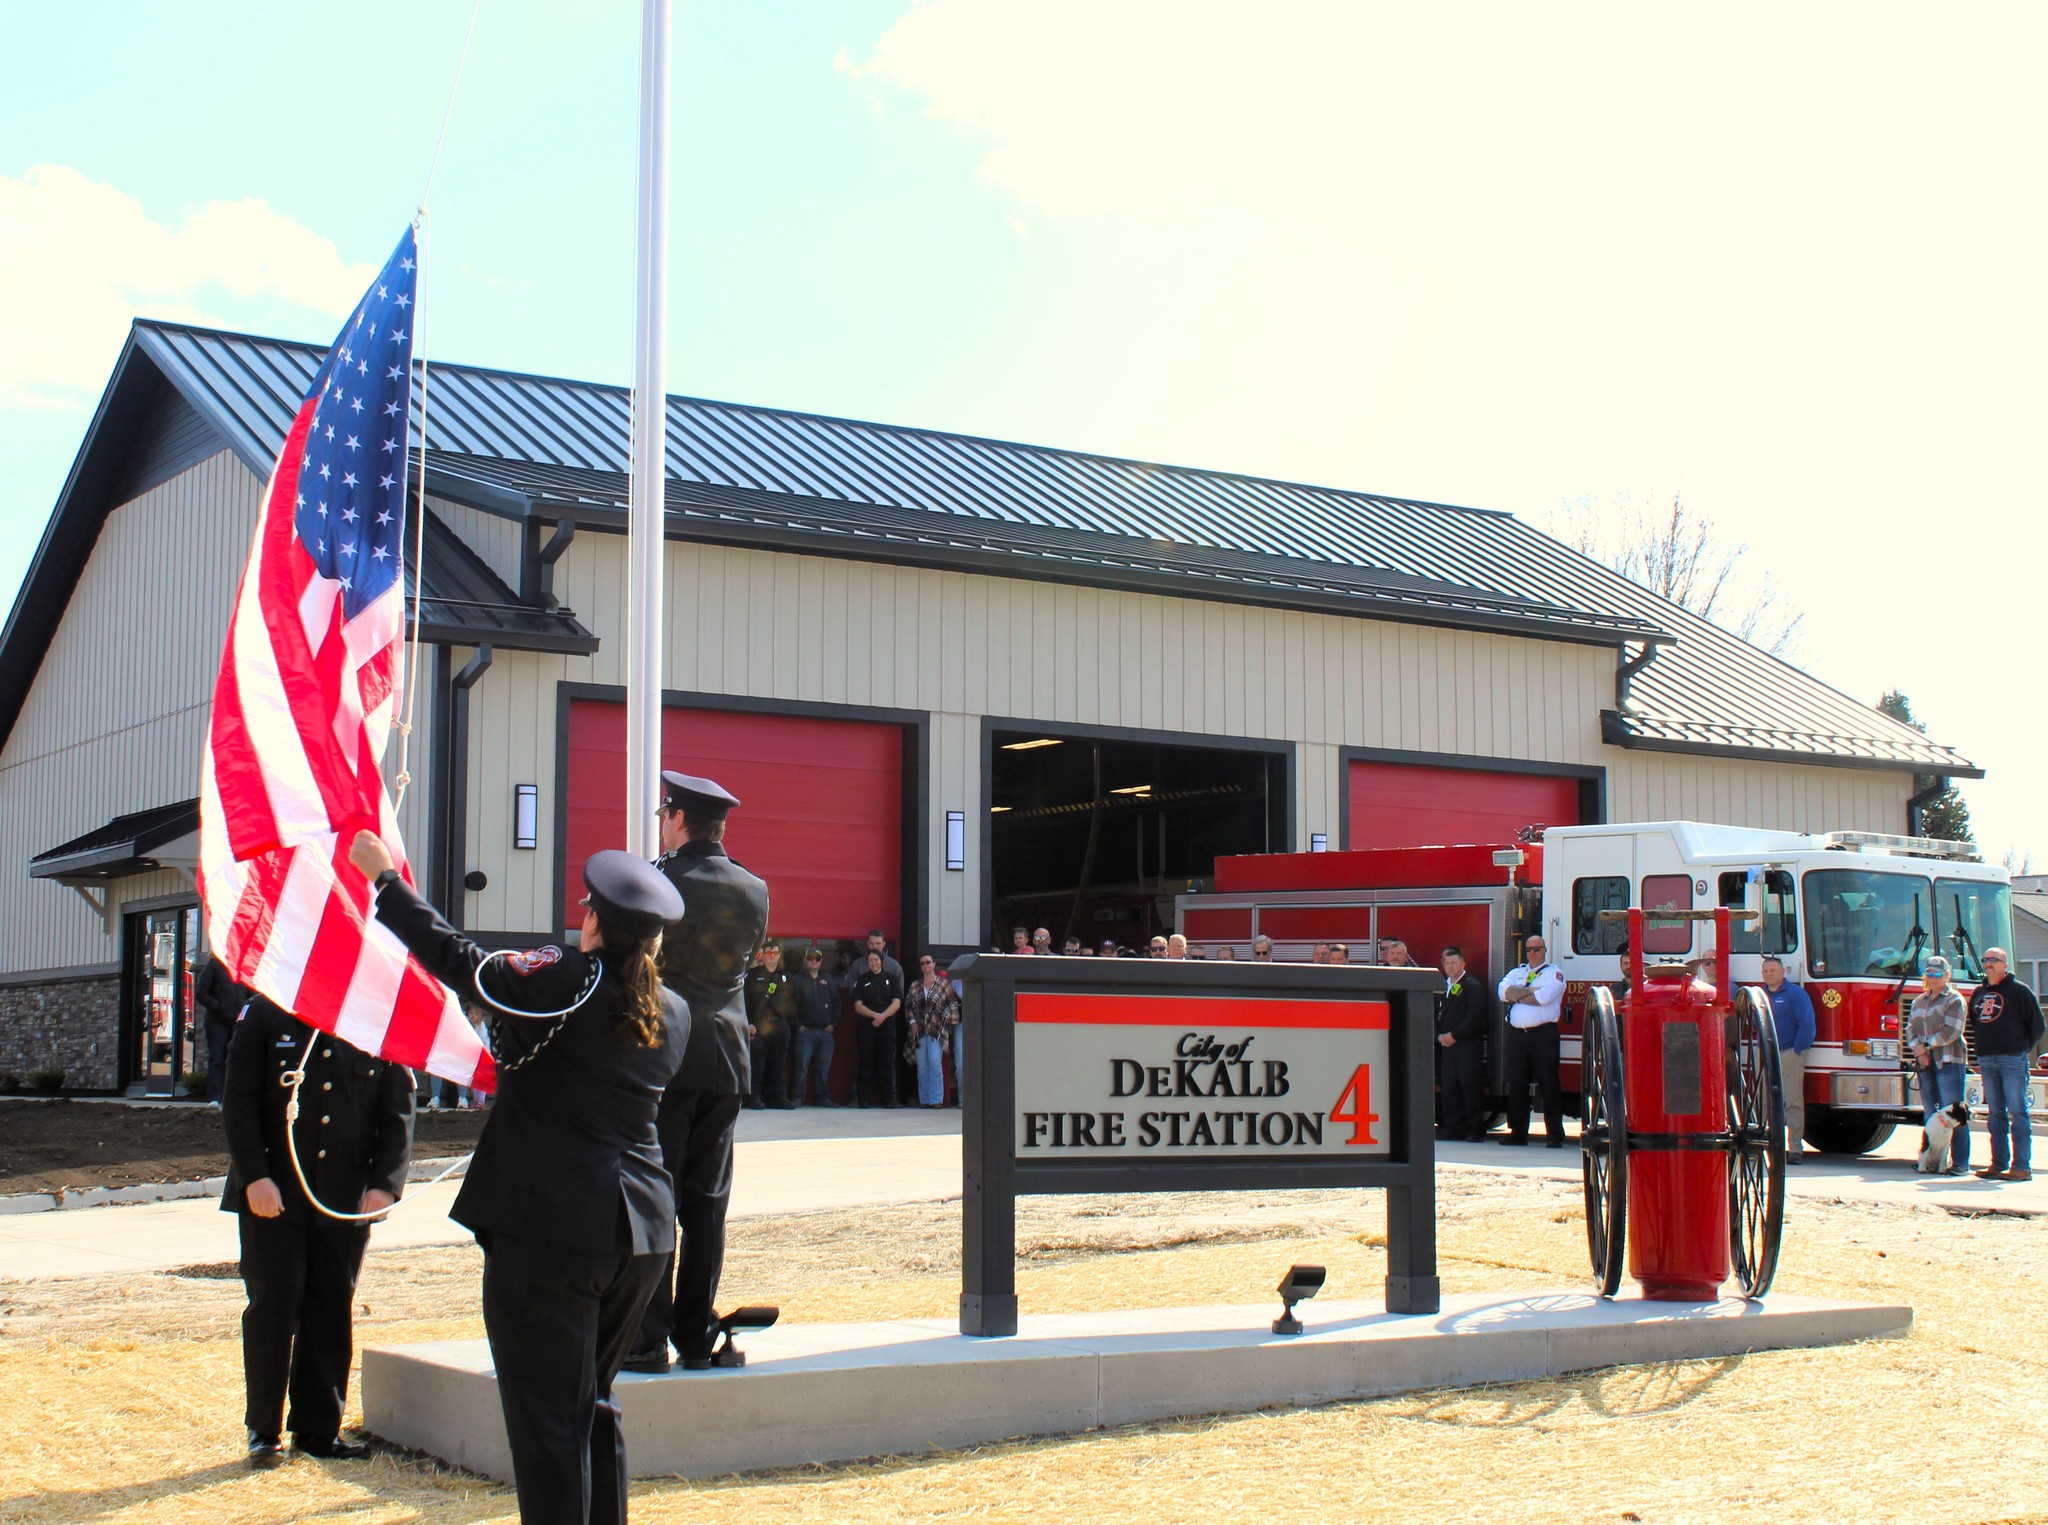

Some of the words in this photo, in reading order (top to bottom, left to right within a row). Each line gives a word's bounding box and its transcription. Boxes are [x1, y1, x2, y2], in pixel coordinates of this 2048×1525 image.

[1568, 982, 1585, 993] DE
[1176, 1032, 1225, 1064] City
[1225, 1036, 1255, 1065] of
[1023, 1112, 1127, 1147] FIRE
[1138, 1111, 1325, 1147] STATION
[1329, 1063, 1379, 1145] 4
